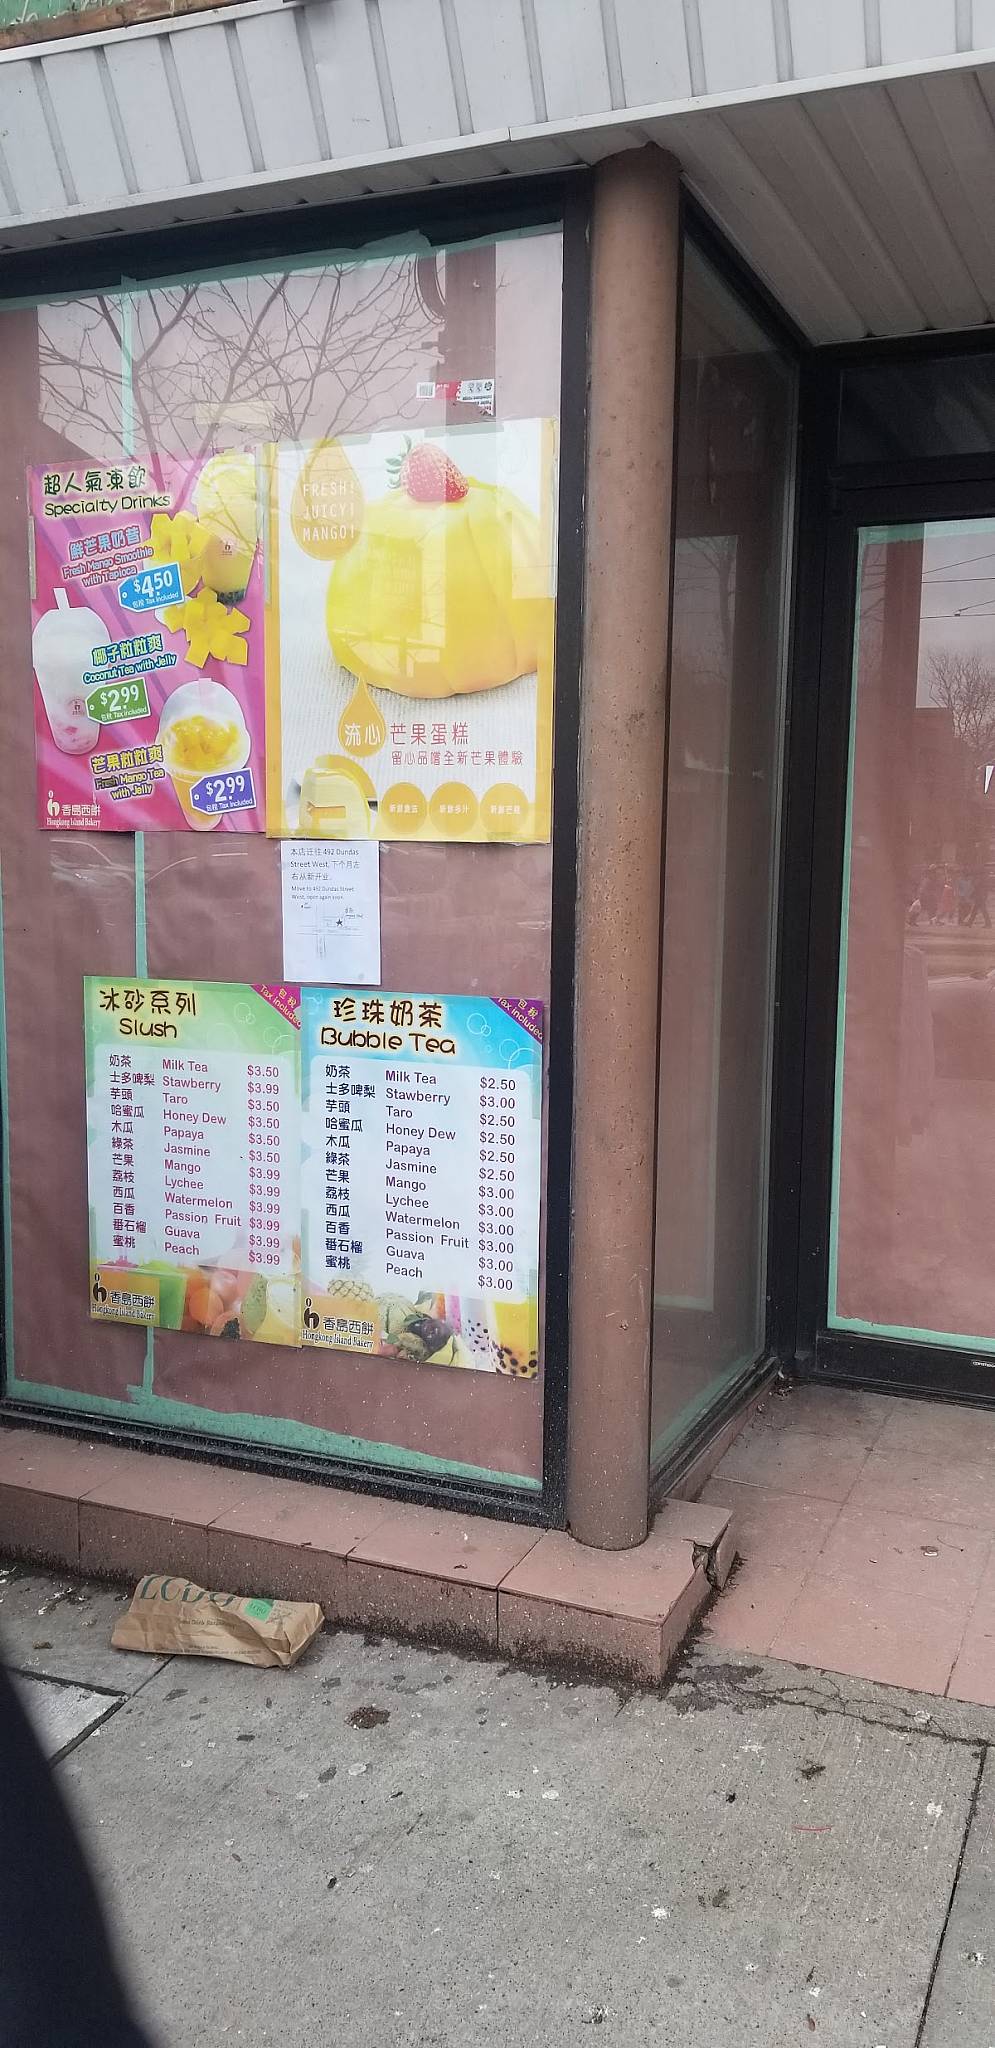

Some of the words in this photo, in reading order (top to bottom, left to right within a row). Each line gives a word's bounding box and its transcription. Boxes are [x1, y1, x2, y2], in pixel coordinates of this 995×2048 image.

[44, 466, 145, 495] 超人氣凍飲
[303, 480, 354, 496] FRESH!
[44, 500, 118, 517] Specialty
[122, 496, 170, 510] Drinks
[303, 502, 354, 520] JUICY!
[303, 524, 354, 541] MANGO!
[63, 564, 86, 578] Fresh
[86, 557, 114, 572] Mango
[114, 546, 154, 566] Smoothie
[82, 574, 102, 586] with
[102, 566, 137, 582] Tapioca
[84, 667, 118, 684] Coconut
[119, 666, 134, 676] Tea
[136, 659, 154, 672] with
[156, 654, 176, 668] Jelly
[100, 684, 139, 712] $2.99
[344, 723, 380, 746] 流心
[390, 722, 469, 746] 芒果蛋糕
[92, 744, 163, 774] 芒果粒粒爽
[94, 776, 118, 790] Fresh
[119, 772, 148, 784] Mango
[147, 768, 165, 780] Tea
[110, 786, 132, 800] with
[132, 782, 152, 796] Jelly
[206, 775, 244, 802] $2.99
[100, 988, 196, 1016] 冰砂系列
[260, 984, 273, 1000] Tax
[334, 997, 442, 1028] 珍珠奶茶
[120, 1018, 178, 1038] Slush
[321, 1026, 402, 1050] Bubble
[409, 1033, 456, 1054] Tea
[109, 1055, 132, 1068] 奶茶
[162, 1059, 184, 1070] Milk
[188, 1061, 208, 1072] Tea
[247, 1065, 279, 1078] $3.50
[325, 1064, 350, 1078] 奶茶
[385, 1070, 410, 1083] Milk
[414, 1072, 437, 1085] Tea
[480, 1077, 516, 1091] $2.50
[109, 1072, 155, 1086] 士多啤梨
[162, 1076, 221, 1092] Stawberry
[247, 1082, 279, 1094] $3.99
[325, 1082, 376, 1099] 士多啤梨
[386, 1088, 451, 1106] Stawberry
[480, 1095, 515, 1109] $3.00
[110, 1088, 133, 1101] 芋頭
[163, 1093, 188, 1104] Taro
[247, 1100, 280, 1112] $3.50
[111, 1105, 144, 1118] 哈蜜瓜
[163, 1110, 198, 1124] Honey
[202, 1113, 226, 1125] Dew
[248, 1116, 280, 1129] $3.50
[326, 1100, 350, 1113] 芋頭
[386, 1105, 413, 1118] Taro
[479, 1114, 515, 1128] $2.50
[111, 1121, 134, 1134] 木瓜
[164, 1126, 204, 1141] Papaya
[249, 1133, 280, 1146] $3.50
[325, 1118, 363, 1133] 哈蜜瓜
[386, 1123, 425, 1140] Honey
[428, 1128, 456, 1141] Dew
[479, 1132, 515, 1146] $2.50
[111, 1137, 134, 1150] 綠茶
[164, 1143, 210, 1157] Jasmine
[249, 1150, 280, 1163] $3.50
[325, 1135, 350, 1149] 木瓜
[386, 1141, 430, 1156] Papaya
[479, 1150, 515, 1164] $2.50
[112, 1153, 134, 1166] 芒果
[164, 1160, 201, 1173] Mango
[249, 1167, 280, 1180] $3.99
[325, 1152, 350, 1166] 綠茶
[386, 1159, 437, 1174] Jasmine
[479, 1168, 515, 1182] $2.50
[165, 1176, 204, 1189] Lychee
[249, 1184, 280, 1197] $3.99
[325, 1169, 350, 1184] 芒果
[385, 1176, 426, 1192] Mango
[478, 1186, 515, 1200] $3.00
[113, 1186, 135, 1199] 西瓜
[165, 1192, 233, 1208] Watermelon
[249, 1201, 280, 1214] $3.99
[385, 1194, 429, 1209] Lychee
[478, 1204, 514, 1218] $3.00
[113, 1202, 135, 1216] 百香
[165, 1209, 208, 1224] Passion
[215, 1214, 241, 1226] Fruit
[249, 1218, 280, 1231] $3.99
[326, 1204, 350, 1218] 西瓜
[385, 1211, 460, 1229] Watermelon
[478, 1222, 514, 1236] $3.00
[113, 1235, 135, 1248] 蜜桃
[164, 1242, 200, 1255] Peach
[248, 1252, 280, 1265] $3.99
[165, 1226, 200, 1239] Guava
[249, 1235, 280, 1248] $3.99
[325, 1221, 350, 1235] 百香
[386, 1228, 434, 1244] Passion
[441, 1235, 469, 1249] Fruit
[478, 1240, 514, 1254] $3.00
[386, 1246, 425, 1261] Guava
[478, 1257, 513, 1272] $3.00
[325, 1255, 350, 1270] 蜜桃
[386, 1263, 423, 1278] Peach
[478, 1275, 513, 1291] $3.00
[110, 1291, 154, 1308] 香島西餅
[302, 1330, 332, 1344] Hongkong
[323, 1316, 373, 1336] 香島西餅
